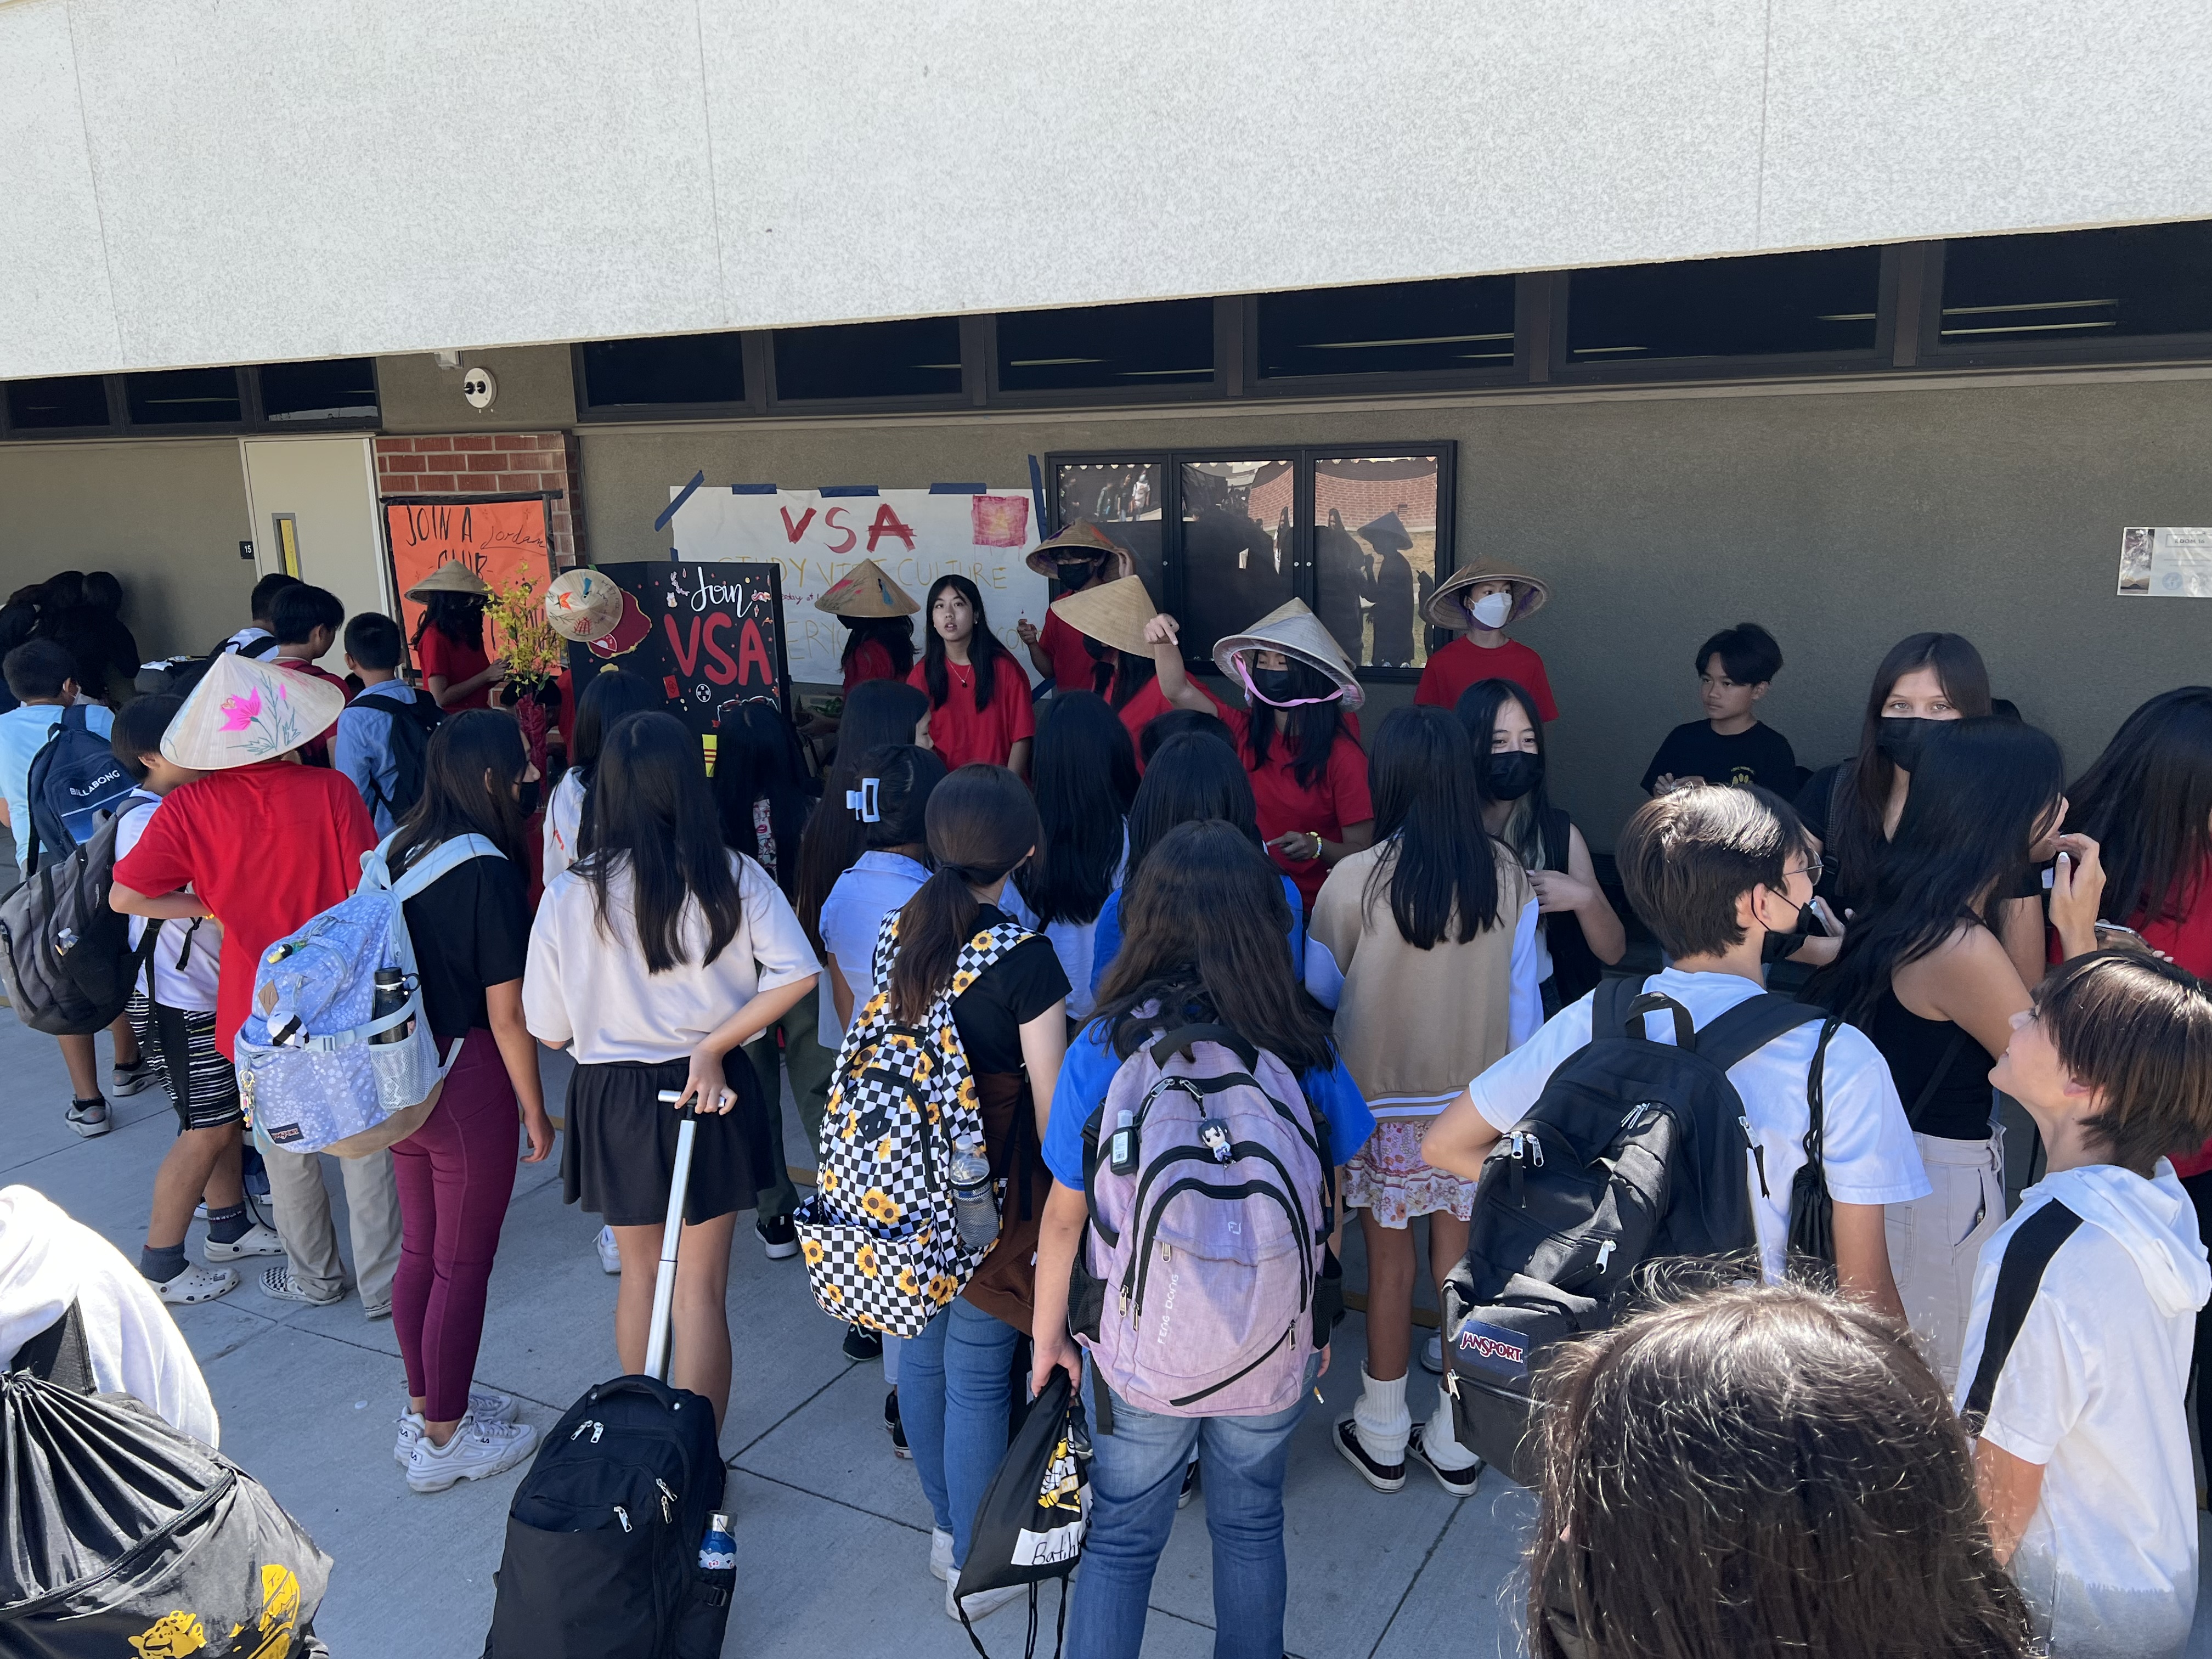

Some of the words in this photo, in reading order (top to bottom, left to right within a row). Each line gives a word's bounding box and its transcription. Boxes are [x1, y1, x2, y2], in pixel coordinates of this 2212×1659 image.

[406, 505, 452, 546] JOIN
[461, 506, 472, 543] A
[780, 503, 917, 553] VSA
[244, 545, 252, 554] 15
[691, 566, 754, 618] Join
[664, 612, 773, 686] VSA
[1459, 1331, 1523, 1362] JANSPORT
